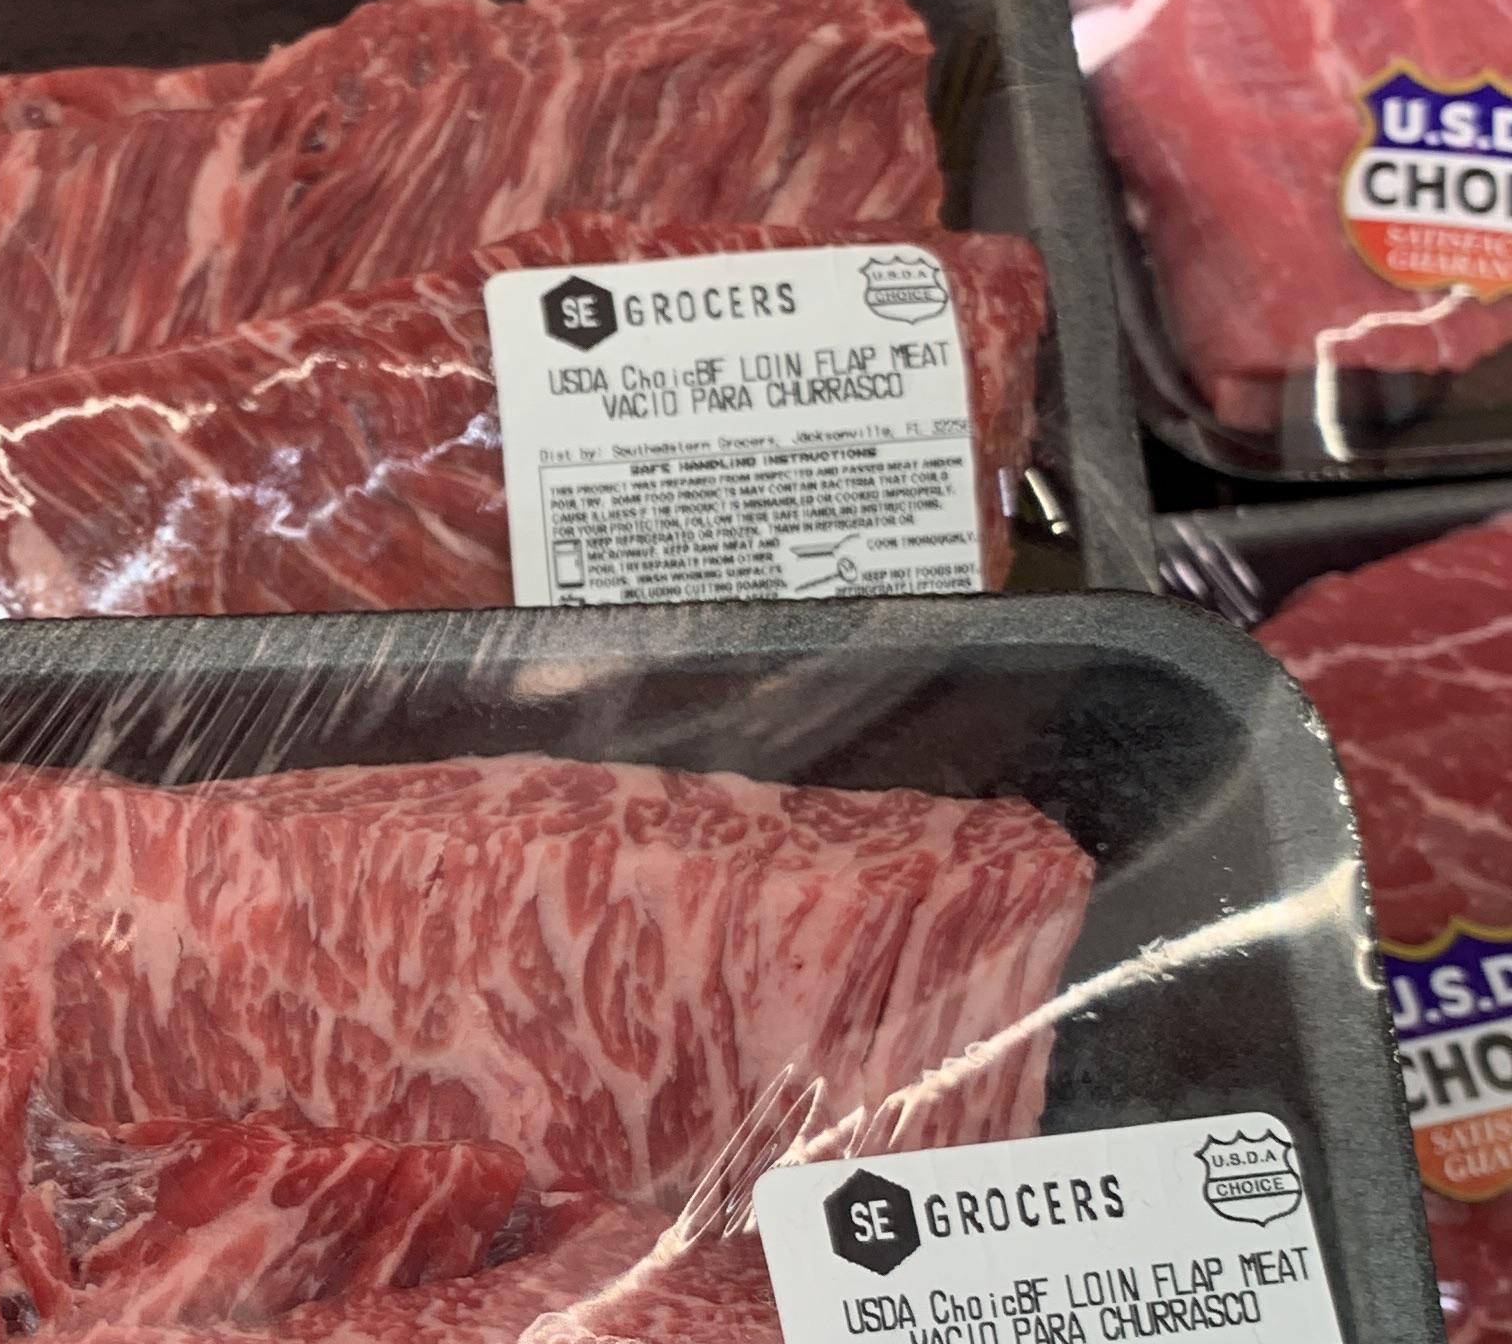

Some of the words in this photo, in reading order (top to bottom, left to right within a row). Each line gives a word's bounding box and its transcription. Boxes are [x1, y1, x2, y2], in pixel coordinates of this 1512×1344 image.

[561, 296, 599, 329] SE
[624, 283, 796, 327] GROCERS
[549, 368, 608, 396] USDA
[740, 353, 803, 381] LOIN
[816, 347, 876, 376] FLAP
[890, 340, 949, 370] MEAT
[602, 390, 678, 419] VACIO
[691, 382, 753, 412] PARA
[766, 372, 903, 408] CHURRASCO
[1211, 1149, 1277, 1168] U.S.D.A
[849, 1199, 896, 1242] SE
[925, 1175, 1126, 1239] GROCERS
[1216, 1178, 1284, 1197] CHOICE
[844, 1297, 916, 1336] USDA
[1066, 1268, 1141, 1309] LOIN
[1150, 1257, 1223, 1299] FLAP
[1240, 1247, 1312, 1287] MEAT
[1099, 1291, 1262, 1340] CHURRASCO
